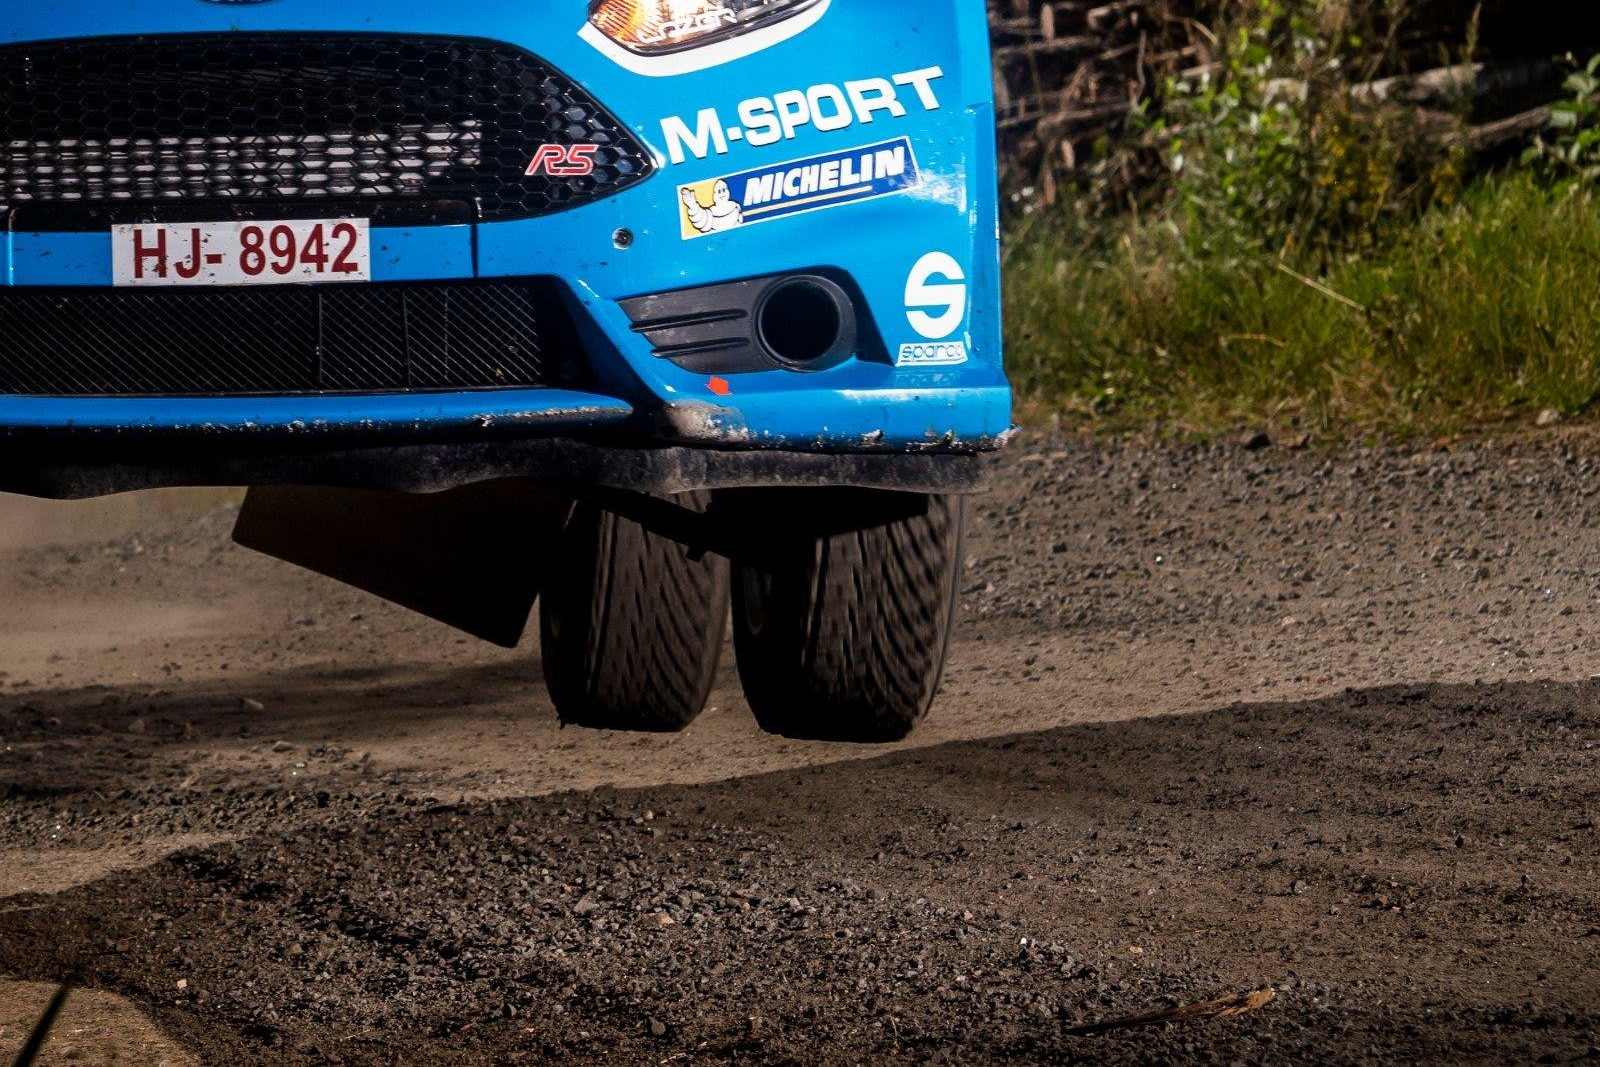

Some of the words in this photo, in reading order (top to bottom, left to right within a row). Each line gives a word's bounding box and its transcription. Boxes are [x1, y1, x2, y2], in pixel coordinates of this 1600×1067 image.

[659, 65, 944, 165] M-SPORT
[744, 146, 905, 206] MICHELIN
[239, 222, 358, 276] 8942
